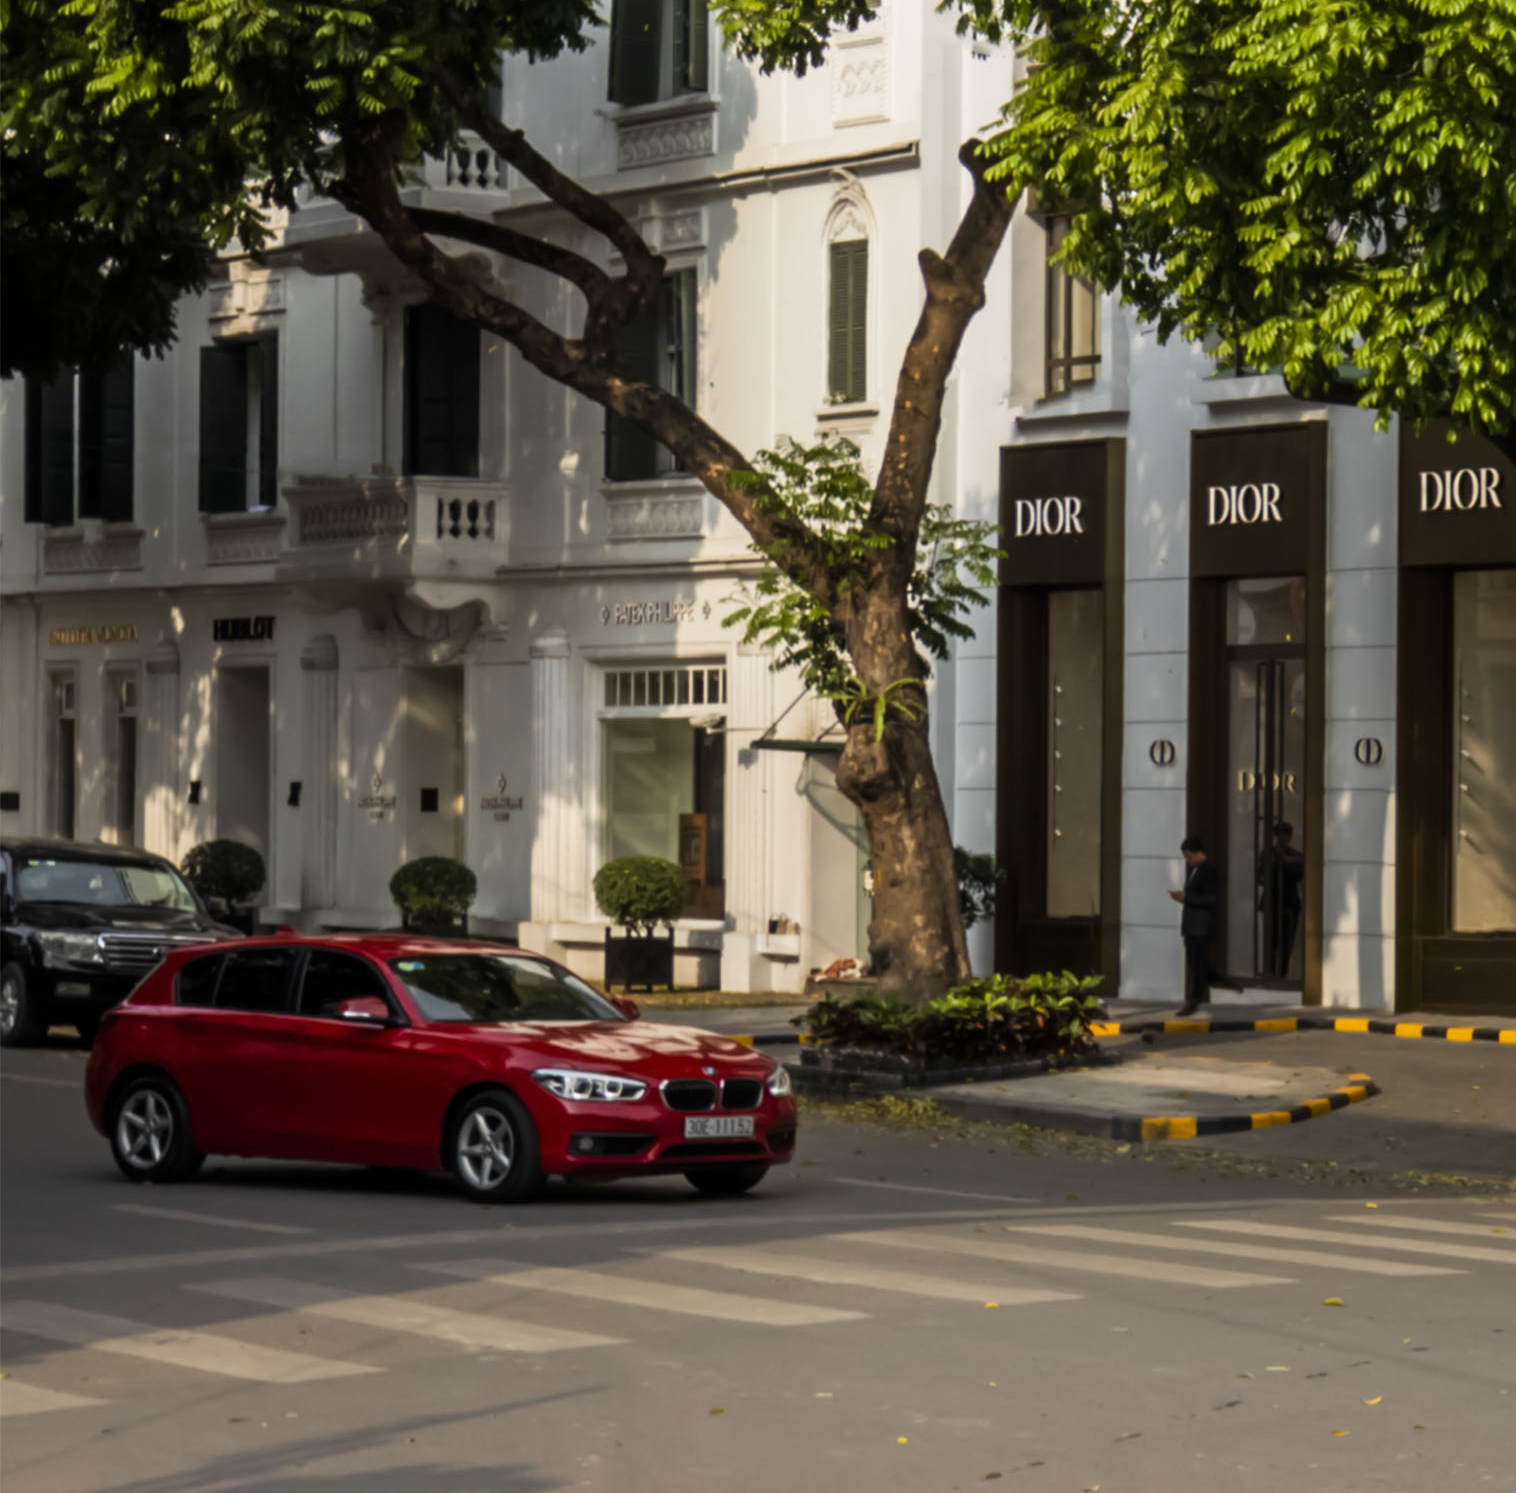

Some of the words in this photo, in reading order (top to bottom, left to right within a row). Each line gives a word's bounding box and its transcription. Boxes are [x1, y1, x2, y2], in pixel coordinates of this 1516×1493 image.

[1208, 483, 1282, 525] DIOR
[1419, 467, 1502, 512] DIOR
[1015, 496, 1083, 536] DIOR
